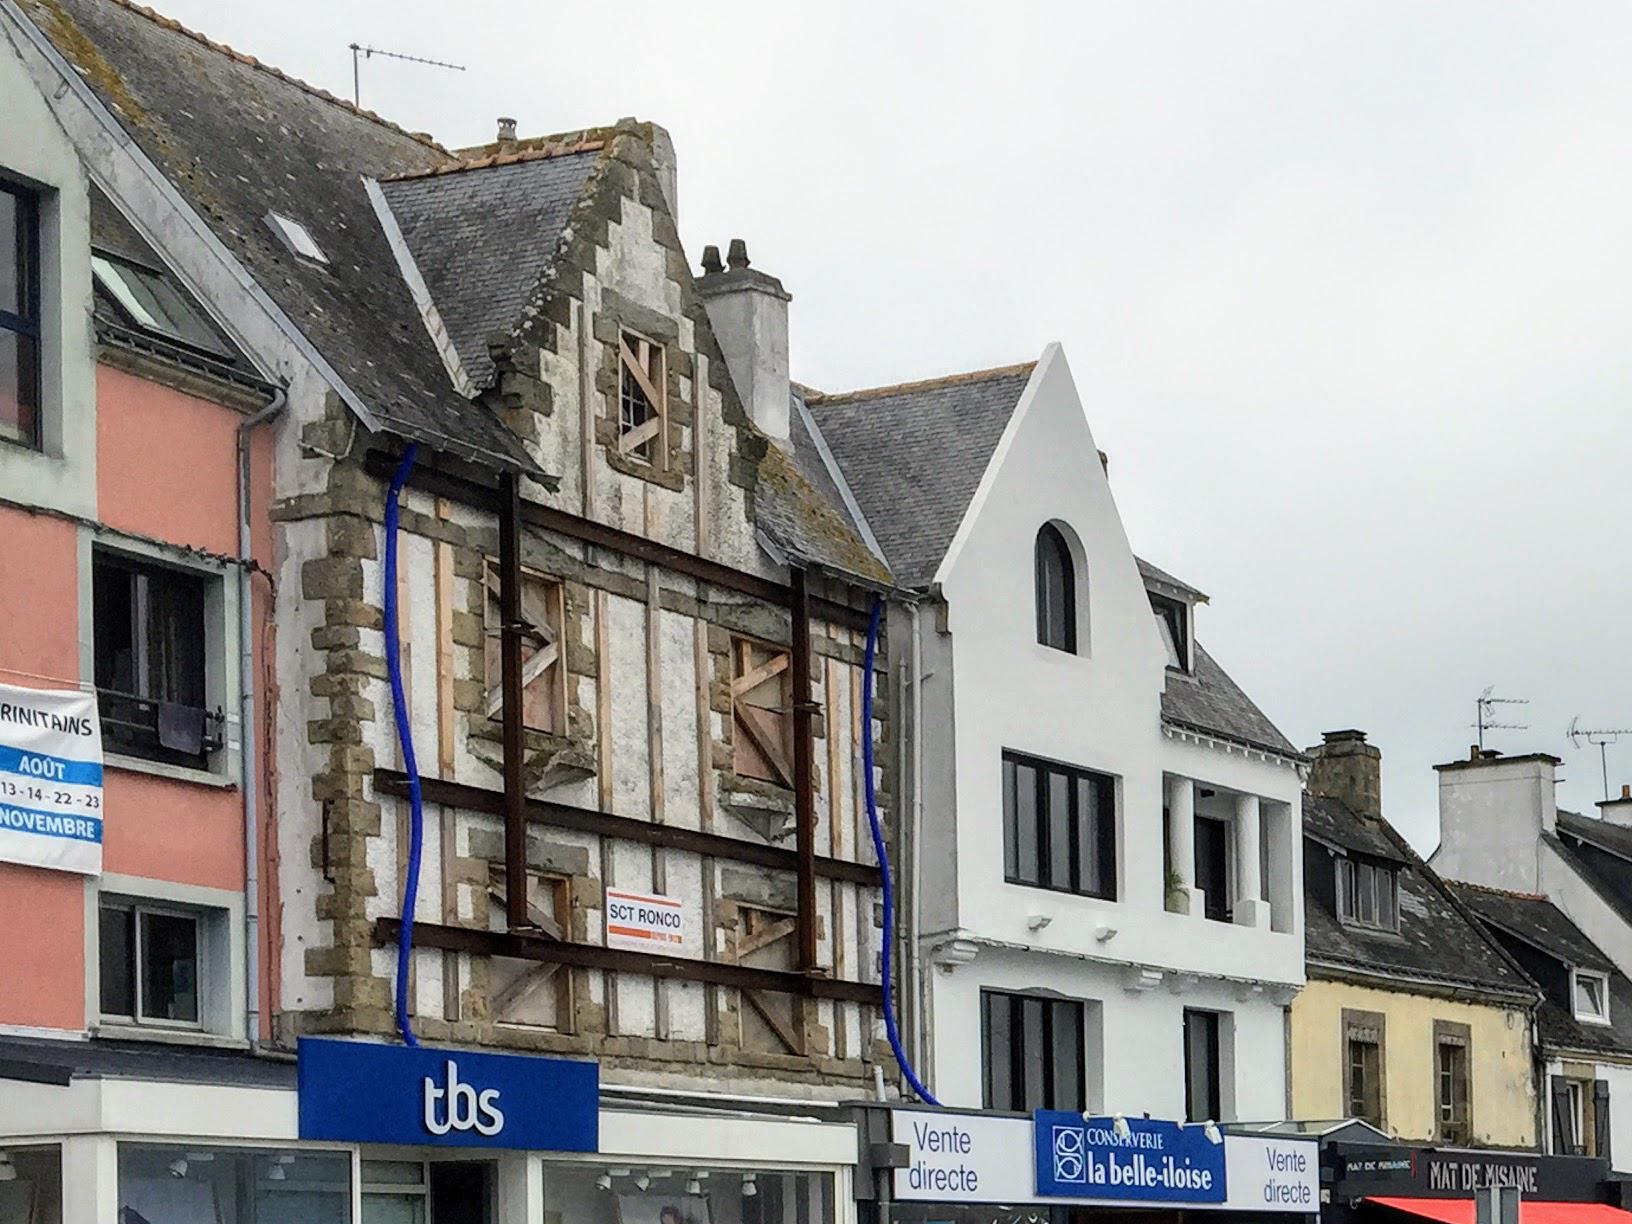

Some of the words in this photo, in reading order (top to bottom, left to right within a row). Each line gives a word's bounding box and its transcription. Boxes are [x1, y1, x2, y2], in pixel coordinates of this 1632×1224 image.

[0, 703, 92, 736] RINITAINS
[18, 754, 65, 780] AOÛT
[1, 782, 16, 796] 13
[28, 787, 42, 801] 14
[54, 792, 72, 805] 22
[86, 794, 99, 808] 23
[0, 808, 95, 838] NOVEMBRE
[610, 904, 634, 921] SCT
[638, 908, 681, 928] RONCO
[424, 1060, 504, 1135] tbs
[914, 1122, 971, 1154] Vente
[1088, 1151, 1106, 1184] la
[1109, 1152, 1213, 1190] belle-iloise
[1266, 1147, 1306, 1173] Vente
[909, 1161, 978, 1192] directe
[1430, 1161, 1458, 1190] MAT
[1462, 1163, 1481, 1190] DE
[1485, 1164, 1538, 1193] MISAINE
[1264, 1181, 1311, 1204] directe
